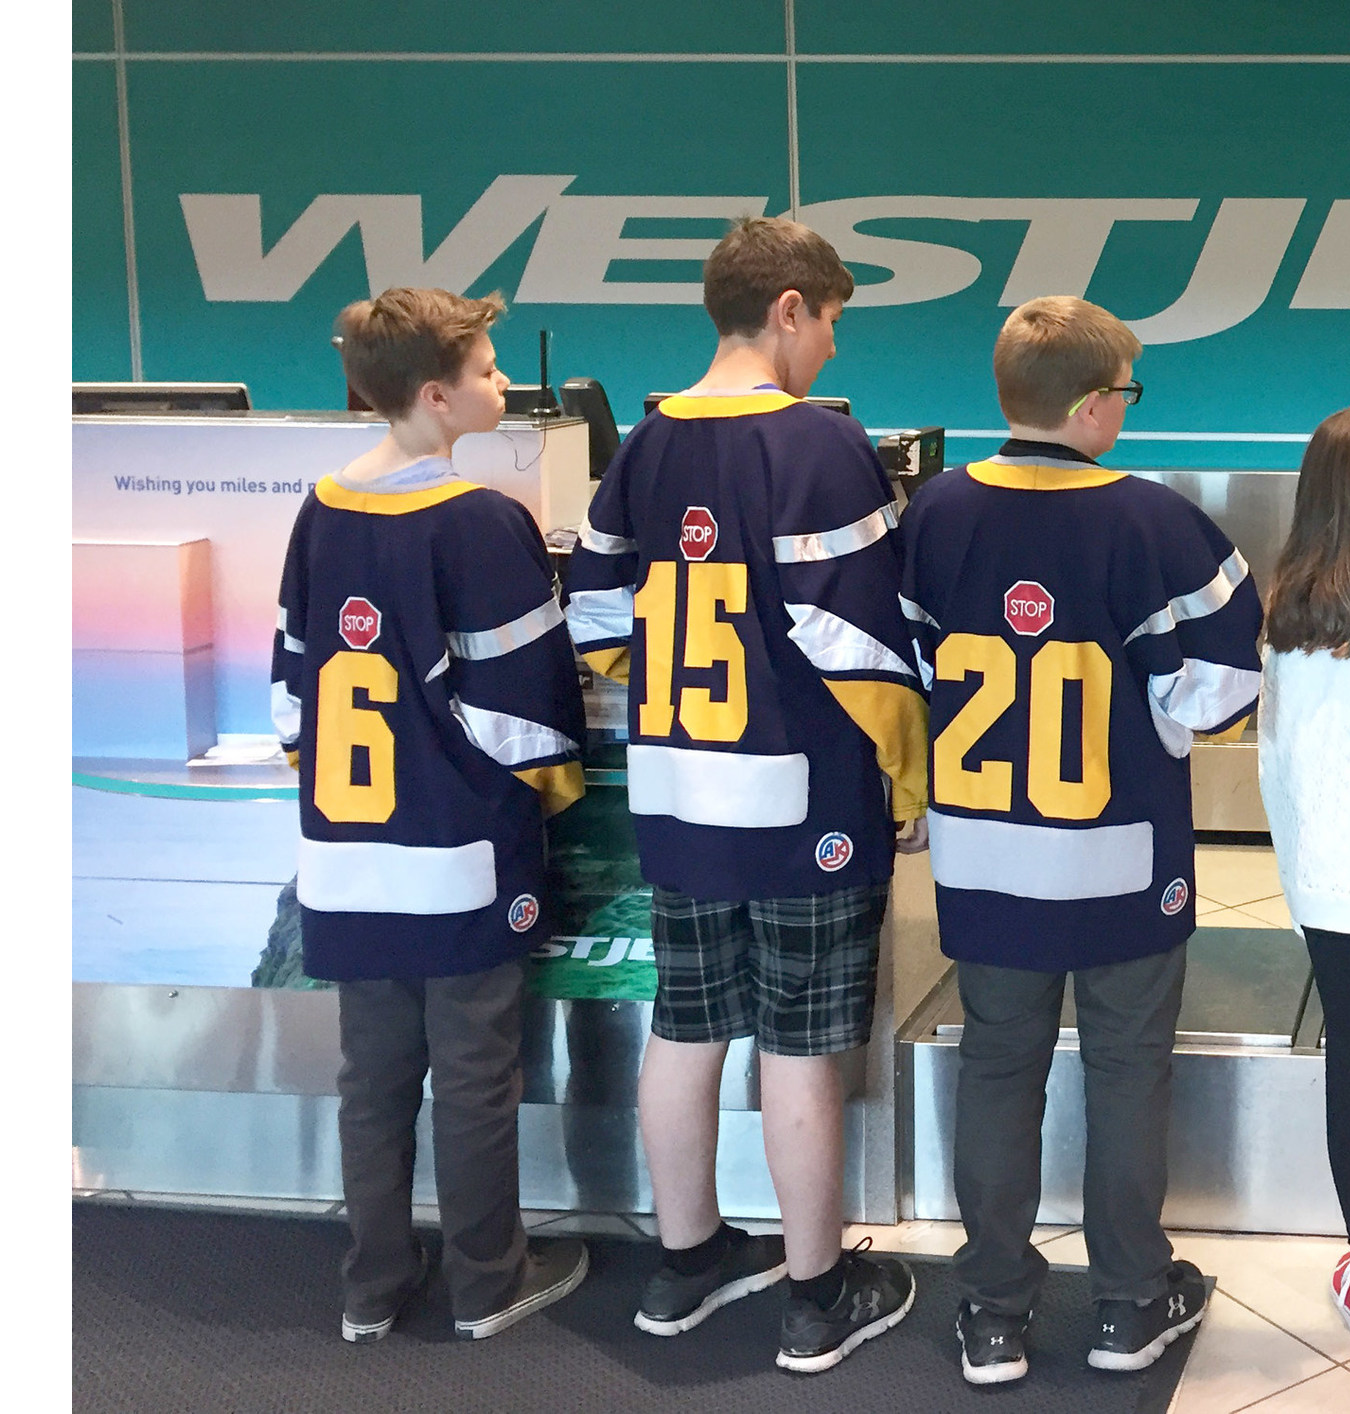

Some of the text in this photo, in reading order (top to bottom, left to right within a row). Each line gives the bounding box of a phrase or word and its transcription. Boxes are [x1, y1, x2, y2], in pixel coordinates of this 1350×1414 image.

[114, 475, 182, 496] Wishing
[187, 479, 216, 496] you
[220, 477, 267, 493] miles
[271, 478, 302, 494] and
[683, 524, 713, 543] STOP
[1010, 598, 1048, 618] STOP
[344, 614, 374, 632] STOP
[634, 561, 748, 742] 15
[314, 651, 399, 824] 6
[934, 632, 1113, 820] 20
[528, 935, 657, 967] STJE
